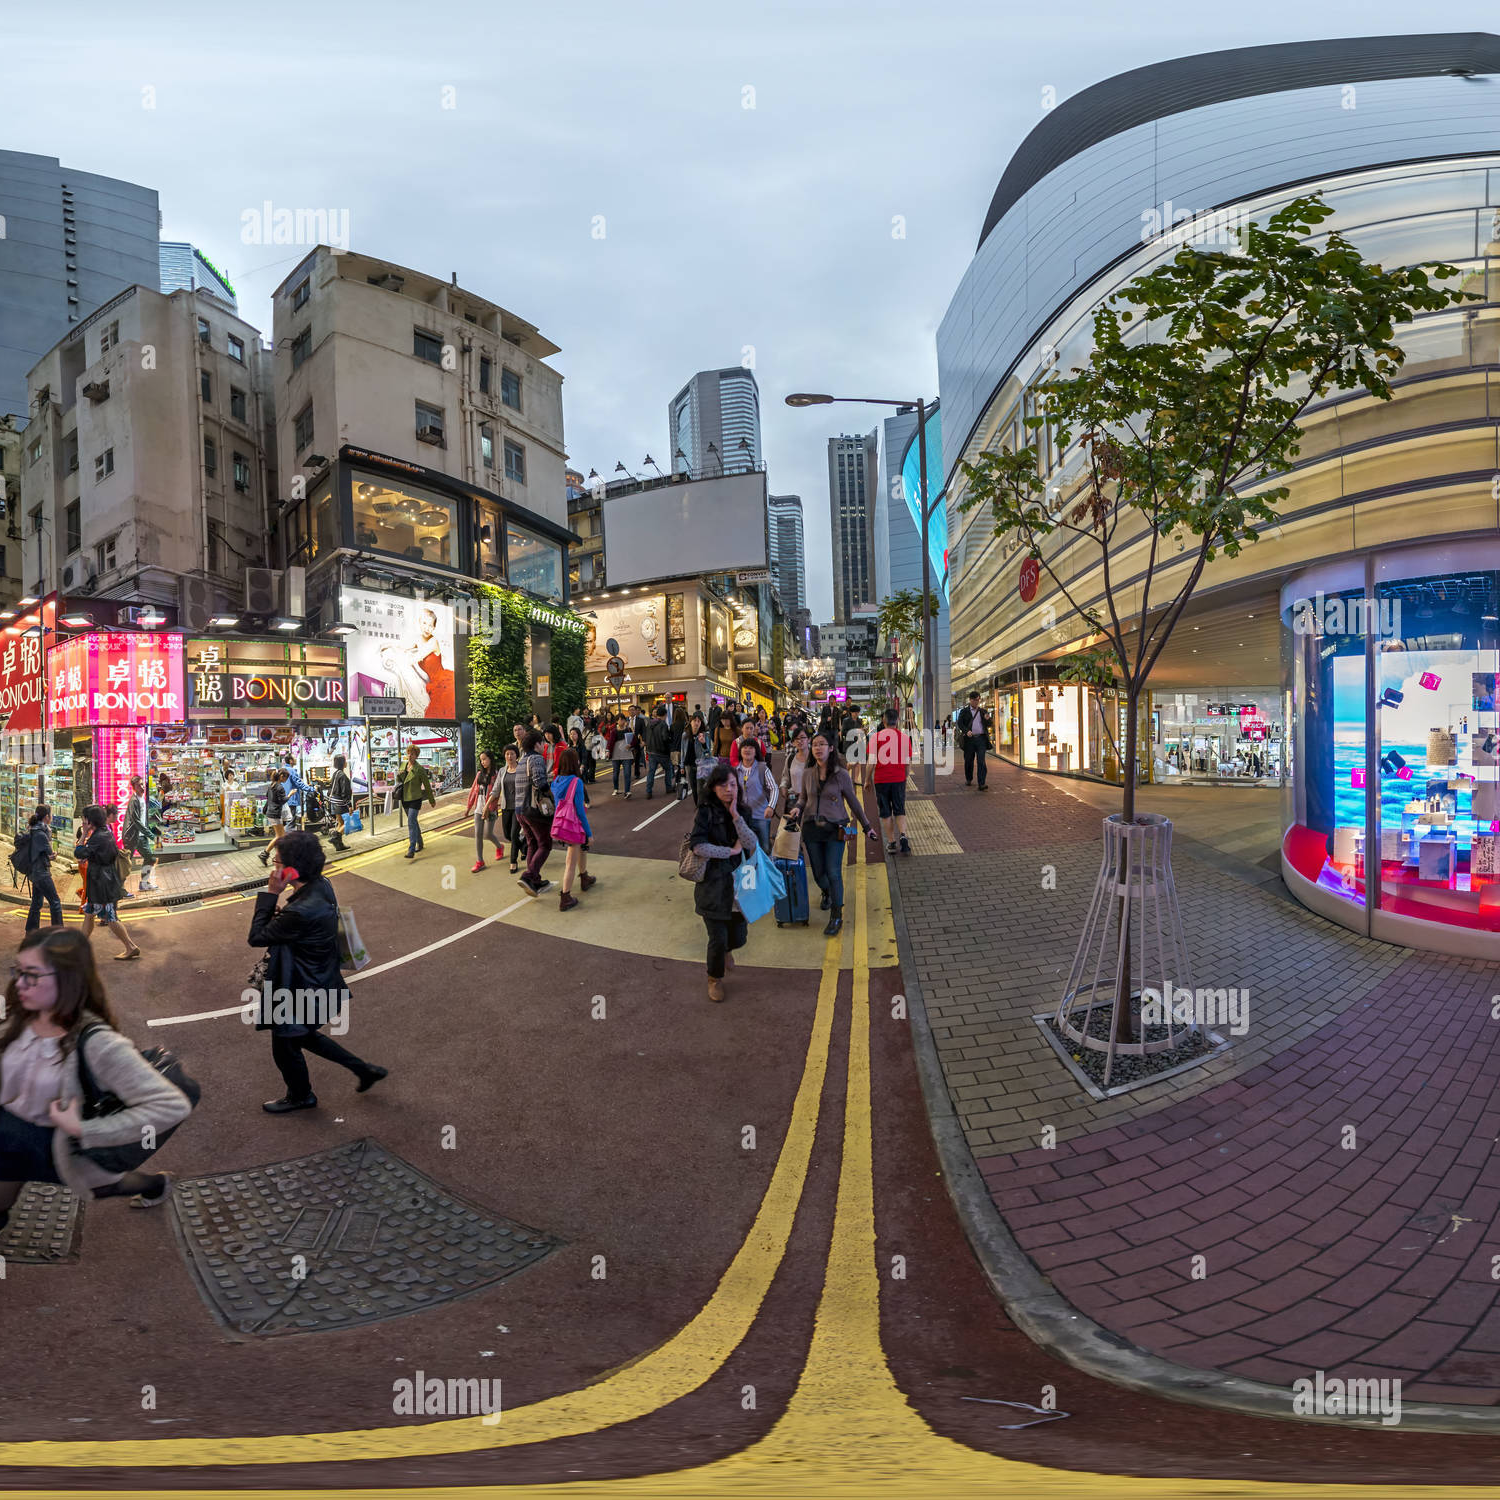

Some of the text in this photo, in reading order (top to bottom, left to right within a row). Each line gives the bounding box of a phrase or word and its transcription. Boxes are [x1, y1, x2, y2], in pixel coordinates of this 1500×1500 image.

[1020, 565, 1036, 592] DFS
[527, 603, 585, 634] innisfree
[50, 694, 88, 713] BONJOUR
[93, 692, 179, 712] BONJOUR
[232, 677, 345, 704] BONJOUR
